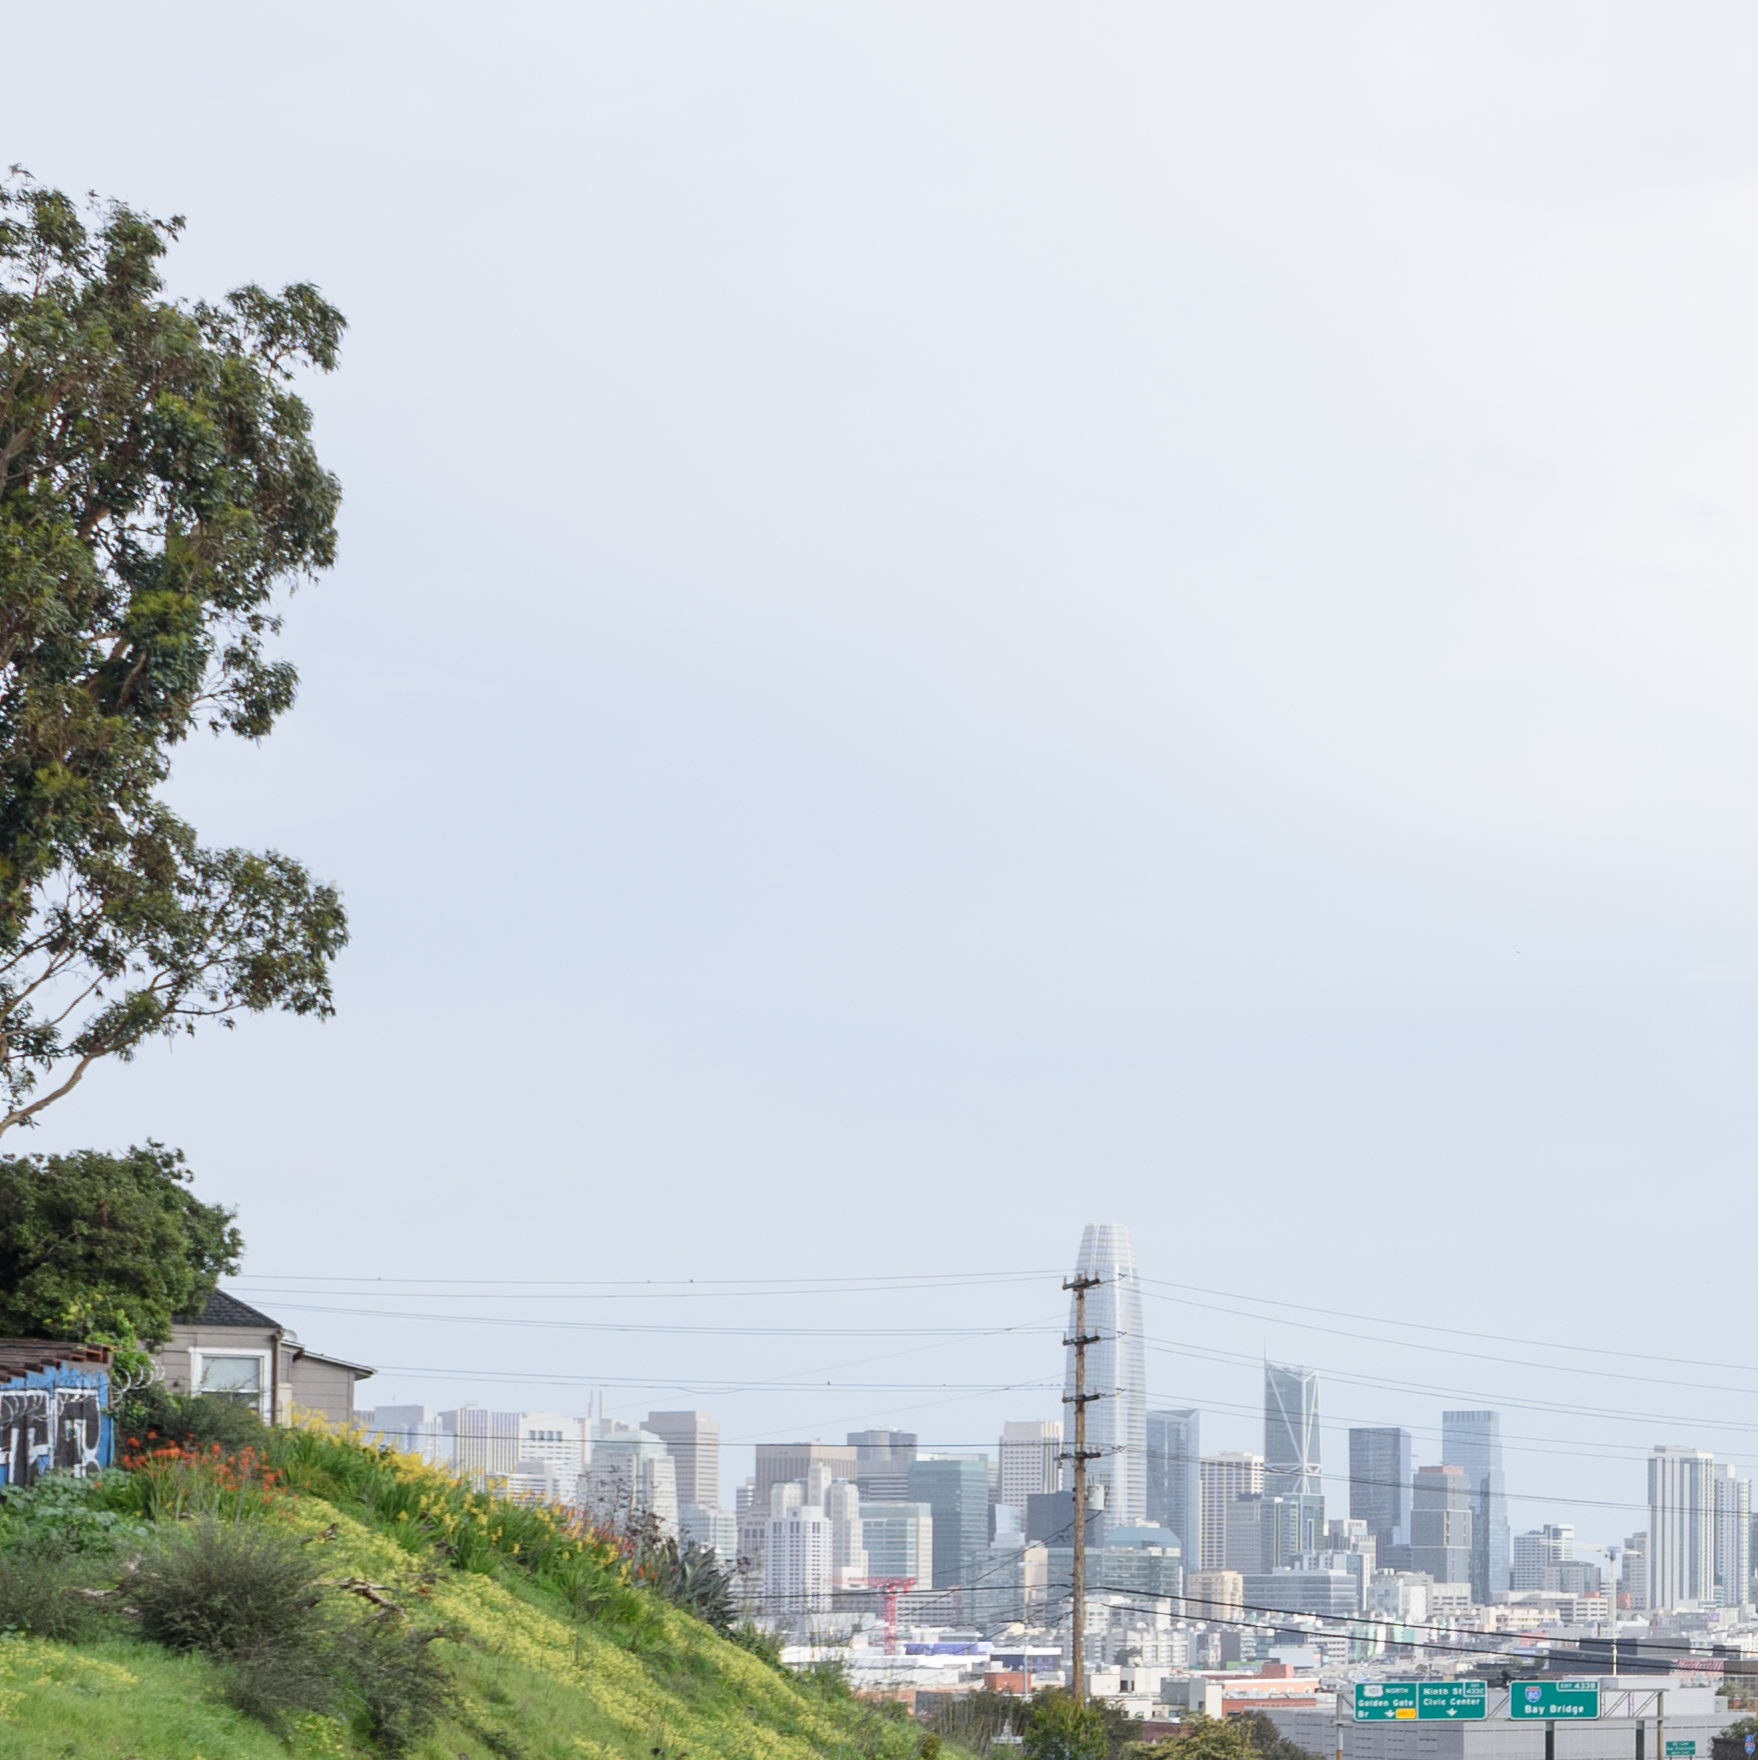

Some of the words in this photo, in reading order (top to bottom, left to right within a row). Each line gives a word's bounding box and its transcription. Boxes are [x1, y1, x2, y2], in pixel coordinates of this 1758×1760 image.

[1385, 1687, 1410, 1695] NORTH
[1422, 1687, 1449, 1696] Ninth
[1452, 1687, 1463, 1696] St
[1358, 1699, 1390, 1708] Golden
[1392, 1699, 1414, 1708] Gate
[1423, 1697, 1447, 1706] Civic
[1449, 1697, 1481, 1706] Center
[1358, 1710, 1370, 1718] Br
[1524, 1704, 1546, 1715] Bay
[1549, 1704, 1584, 1715] Bridge
